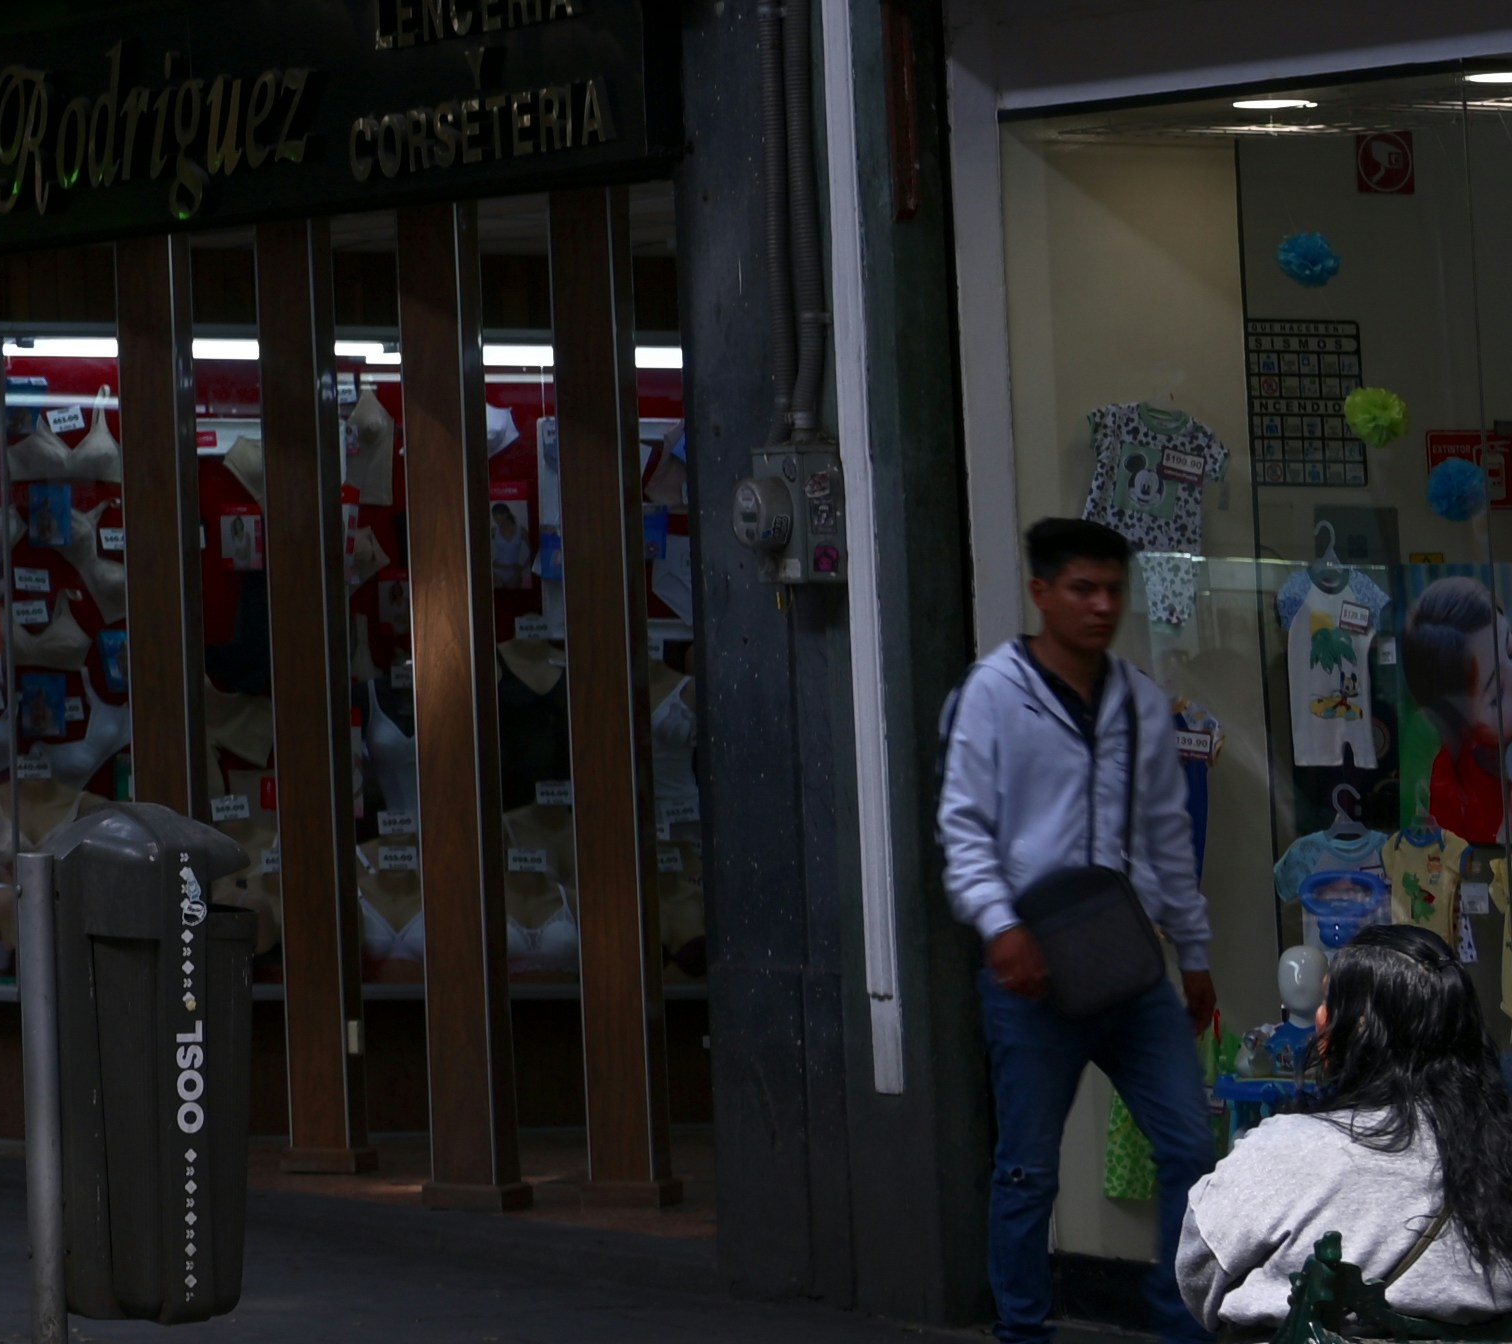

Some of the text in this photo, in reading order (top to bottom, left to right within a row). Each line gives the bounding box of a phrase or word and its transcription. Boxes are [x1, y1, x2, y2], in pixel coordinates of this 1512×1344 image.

[464, 45, 486, 90] Y
[347, 78, 612, 182] CORSETERIA
[1254, 337, 1343, 350] SISMOS
[1250, 400, 1342, 413] INCENDIO
[175, 1019, 205, 1135] OOSL
